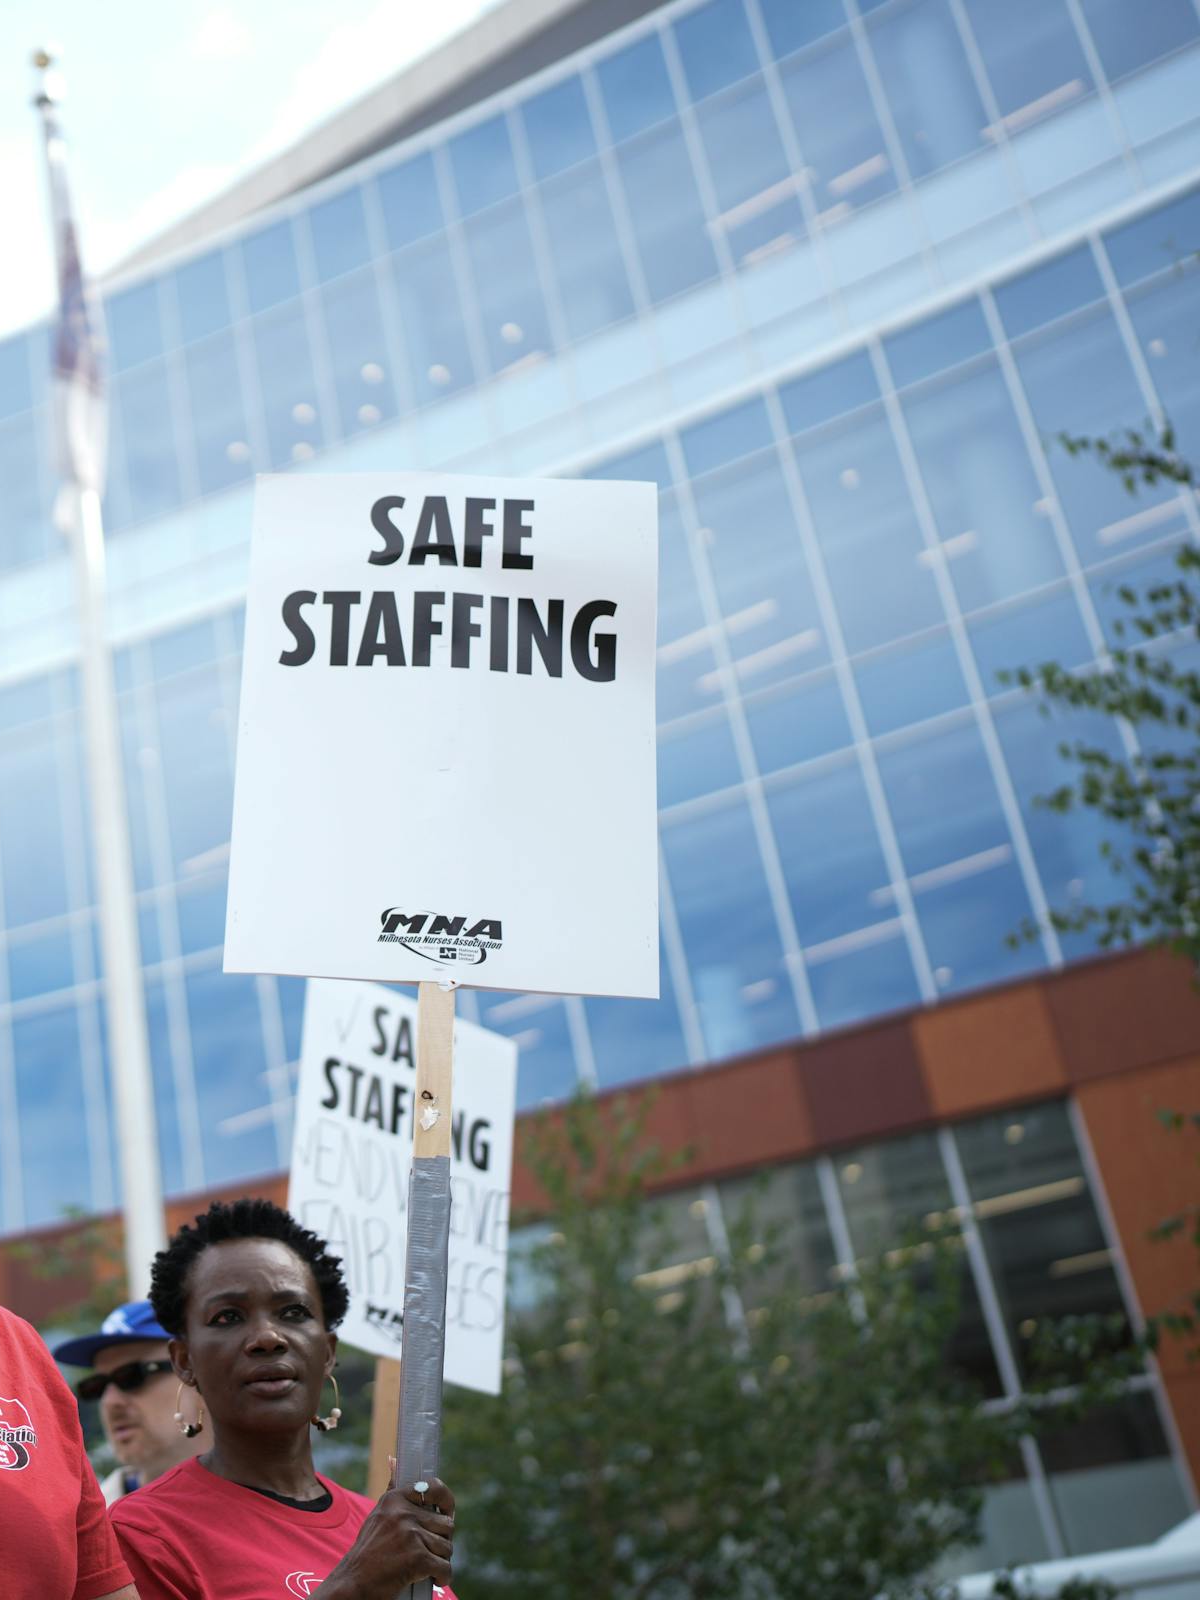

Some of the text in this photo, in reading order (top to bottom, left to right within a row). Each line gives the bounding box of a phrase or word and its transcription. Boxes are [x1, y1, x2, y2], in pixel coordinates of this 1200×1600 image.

[368, 495, 535, 570] SAFE
[278, 590, 618, 683] STAFFING
[378, 934, 502, 950] Minnesota Nurses Association
[381, 914, 502, 940] MNA
[321, 1057, 490, 1171] STAFNG
